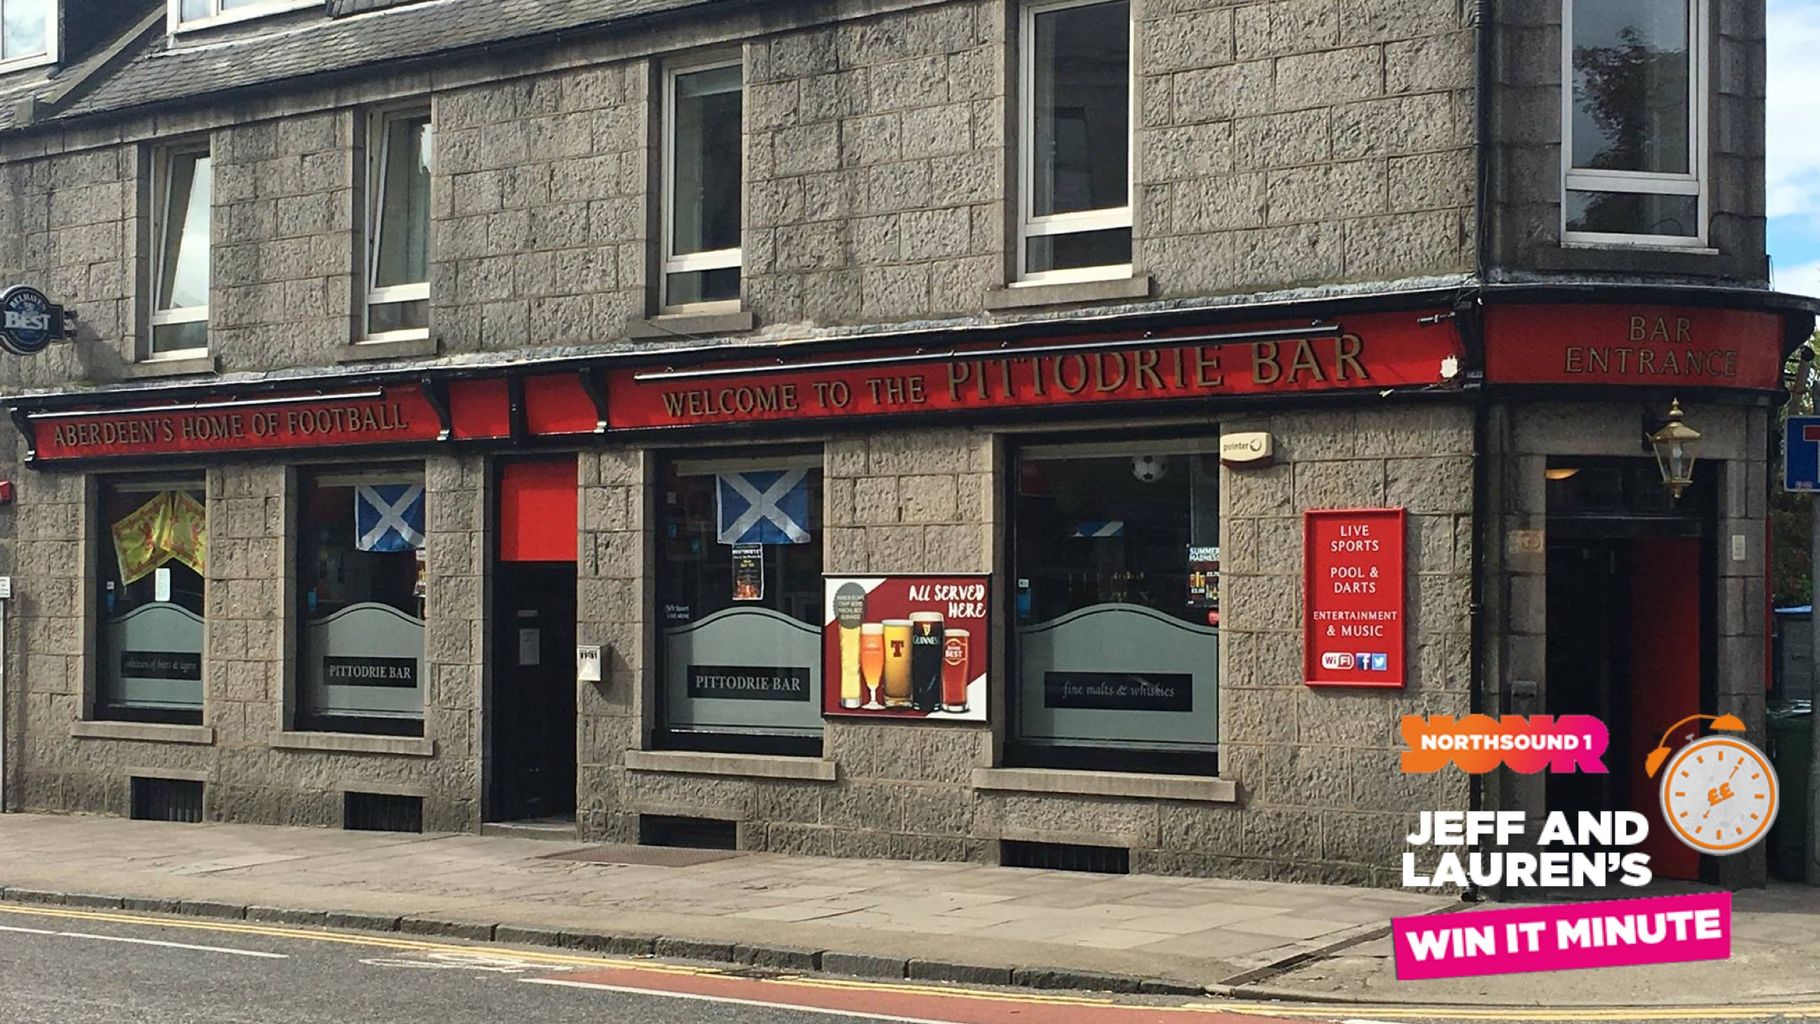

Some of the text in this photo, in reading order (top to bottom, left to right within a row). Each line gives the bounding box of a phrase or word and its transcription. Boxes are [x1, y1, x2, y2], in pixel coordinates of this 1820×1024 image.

[4, 311, 51, 330] BEST
[1629, 316, 1692, 342] BAR
[1565, 347, 1737, 377] ENTRANCE
[662, 334, 1371, 417] WELCOME TO THE PITTODRIE BAR
[54, 404, 408, 447] ABERDEEN'S HOME OF FOOTBALL
[1340, 525, 1370, 537] LIVE
[1330, 539, 1379, 552] SPORTS
[1330, 566, 1379, 579] POOL &
[908, 584, 985, 601] ALL SERVED
[1334, 581, 1376, 594] DARTS
[948, 602, 986, 618] HERE
[1313, 611, 1397, 621] ENTERTAINMENT
[1326, 625, 1384, 637] & MUSIC
[945, 650, 963, 658] BEST
[329, 665, 411, 679] PITTODRIE BAR
[696, 675, 800, 691] PITTODRIE BAR
[1062, 681, 1175, 699] fine malts & whiskies
